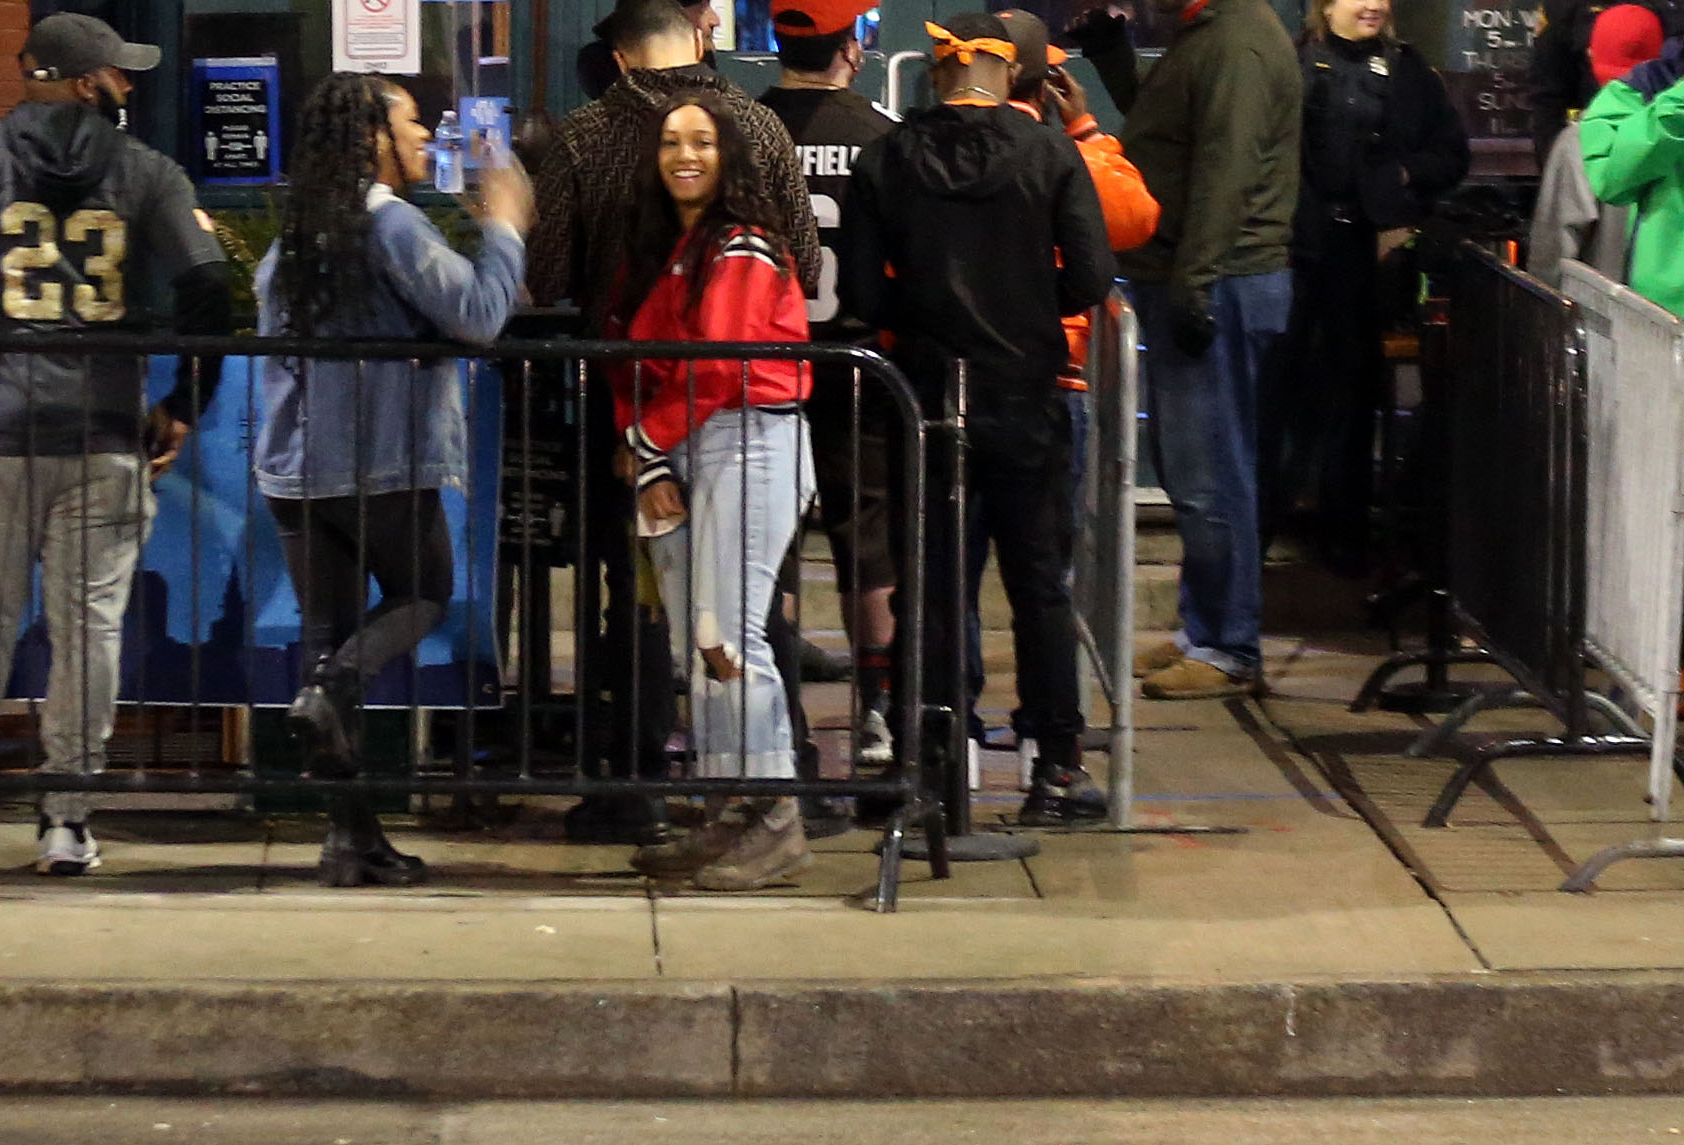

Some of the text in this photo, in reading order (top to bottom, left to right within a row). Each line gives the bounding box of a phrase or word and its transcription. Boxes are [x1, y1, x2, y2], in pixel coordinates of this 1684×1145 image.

[209, 82, 262, 91] PRACTICE
[215, 93, 255, 102] SOCIAL
[203, 105, 267, 114] DISTANCING
[795, 145, 862, 176] FIEL
[0, 201, 127, 322] 23
